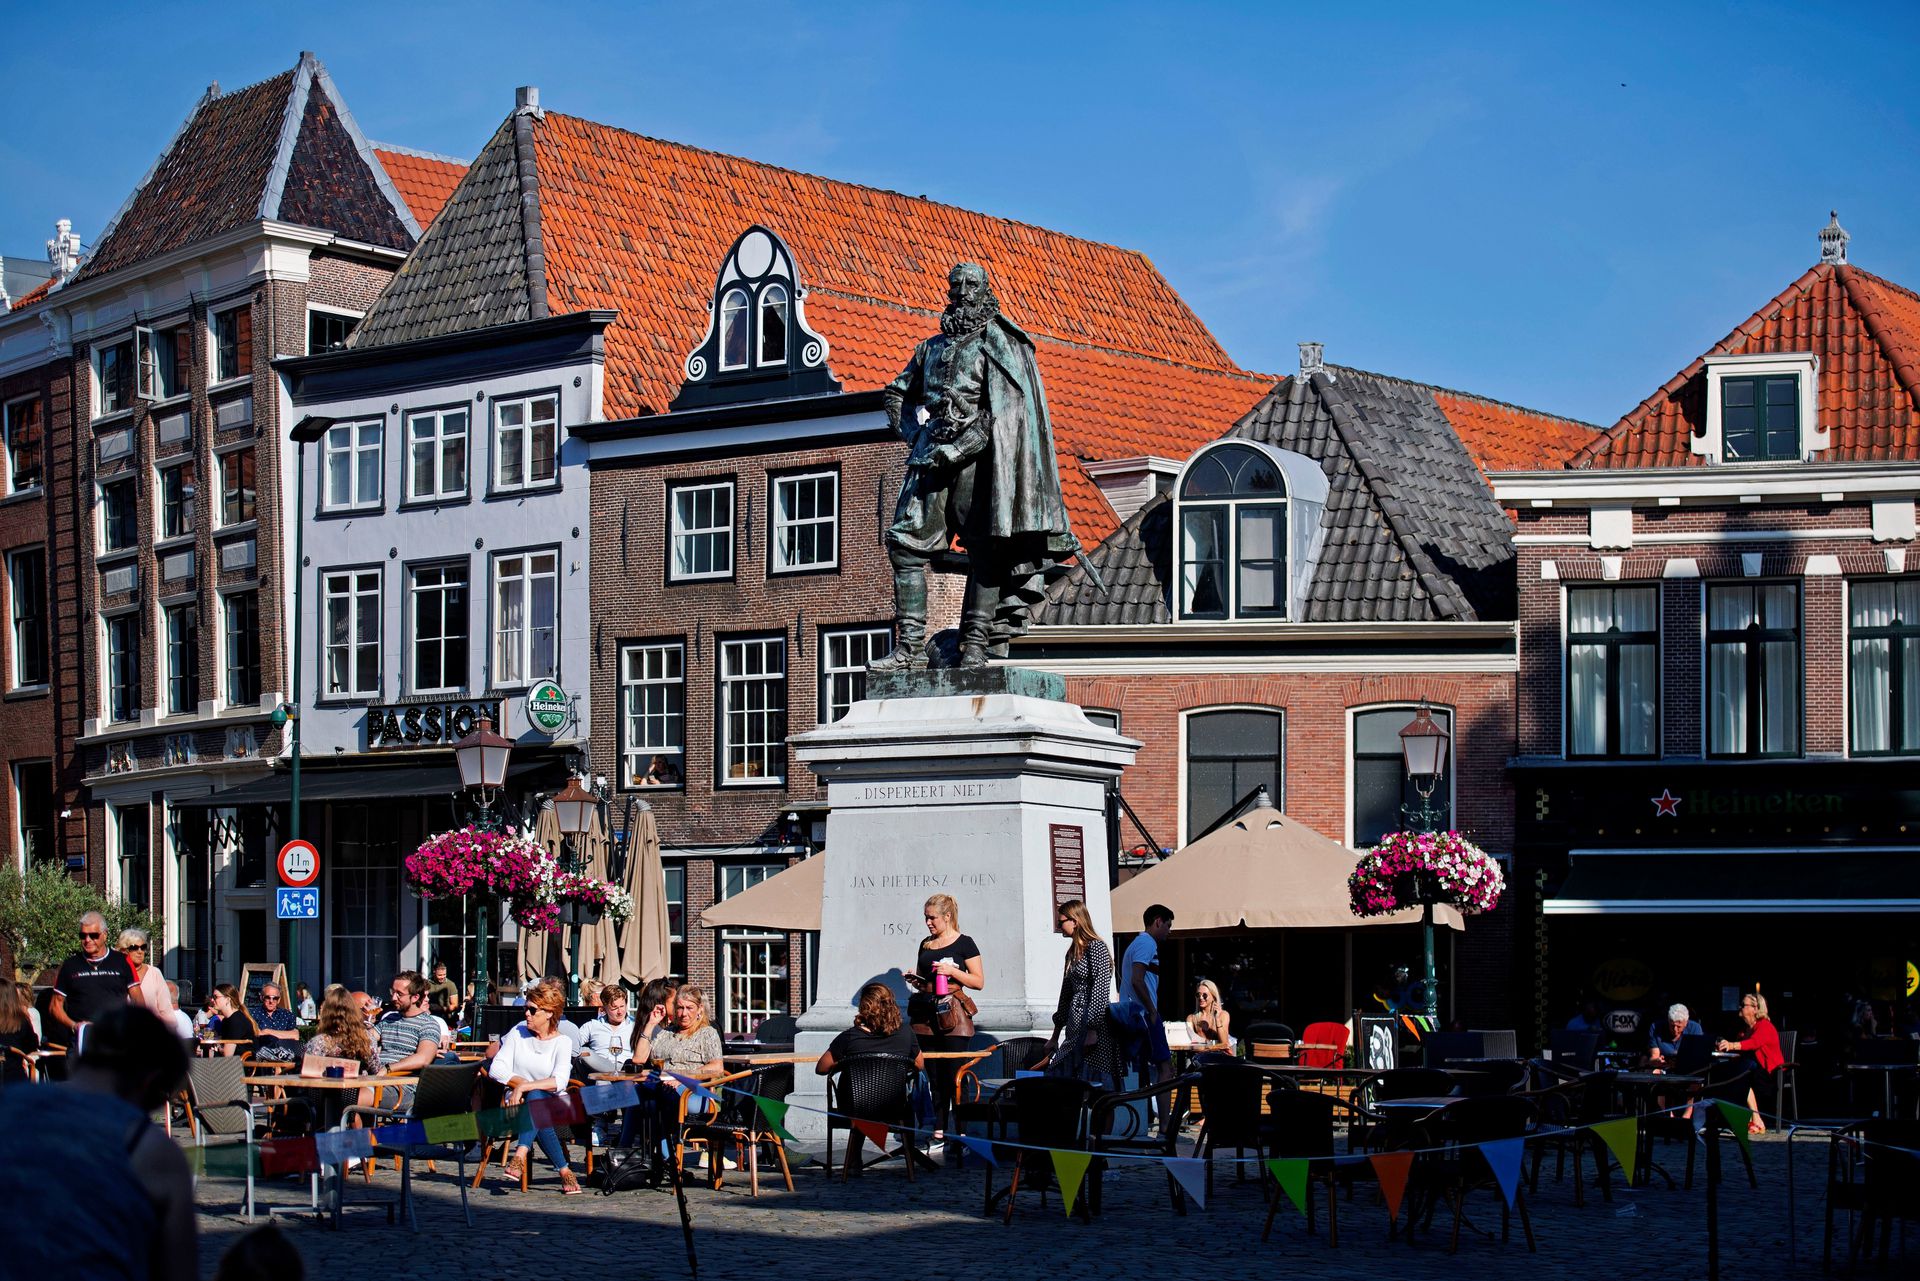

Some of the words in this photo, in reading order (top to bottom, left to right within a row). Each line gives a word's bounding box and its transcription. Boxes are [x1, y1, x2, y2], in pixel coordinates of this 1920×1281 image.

[368, 703, 500, 745] PASSION
[1688, 788, 1844, 815] Heineken
[850, 875, 874, 888] JAN
[882, 874, 948, 888] PIETERSZ
[961, 873, 996, 887] COEN
[882, 923, 912, 936] 1587
[1612, 1014, 1635, 1025] FOX
